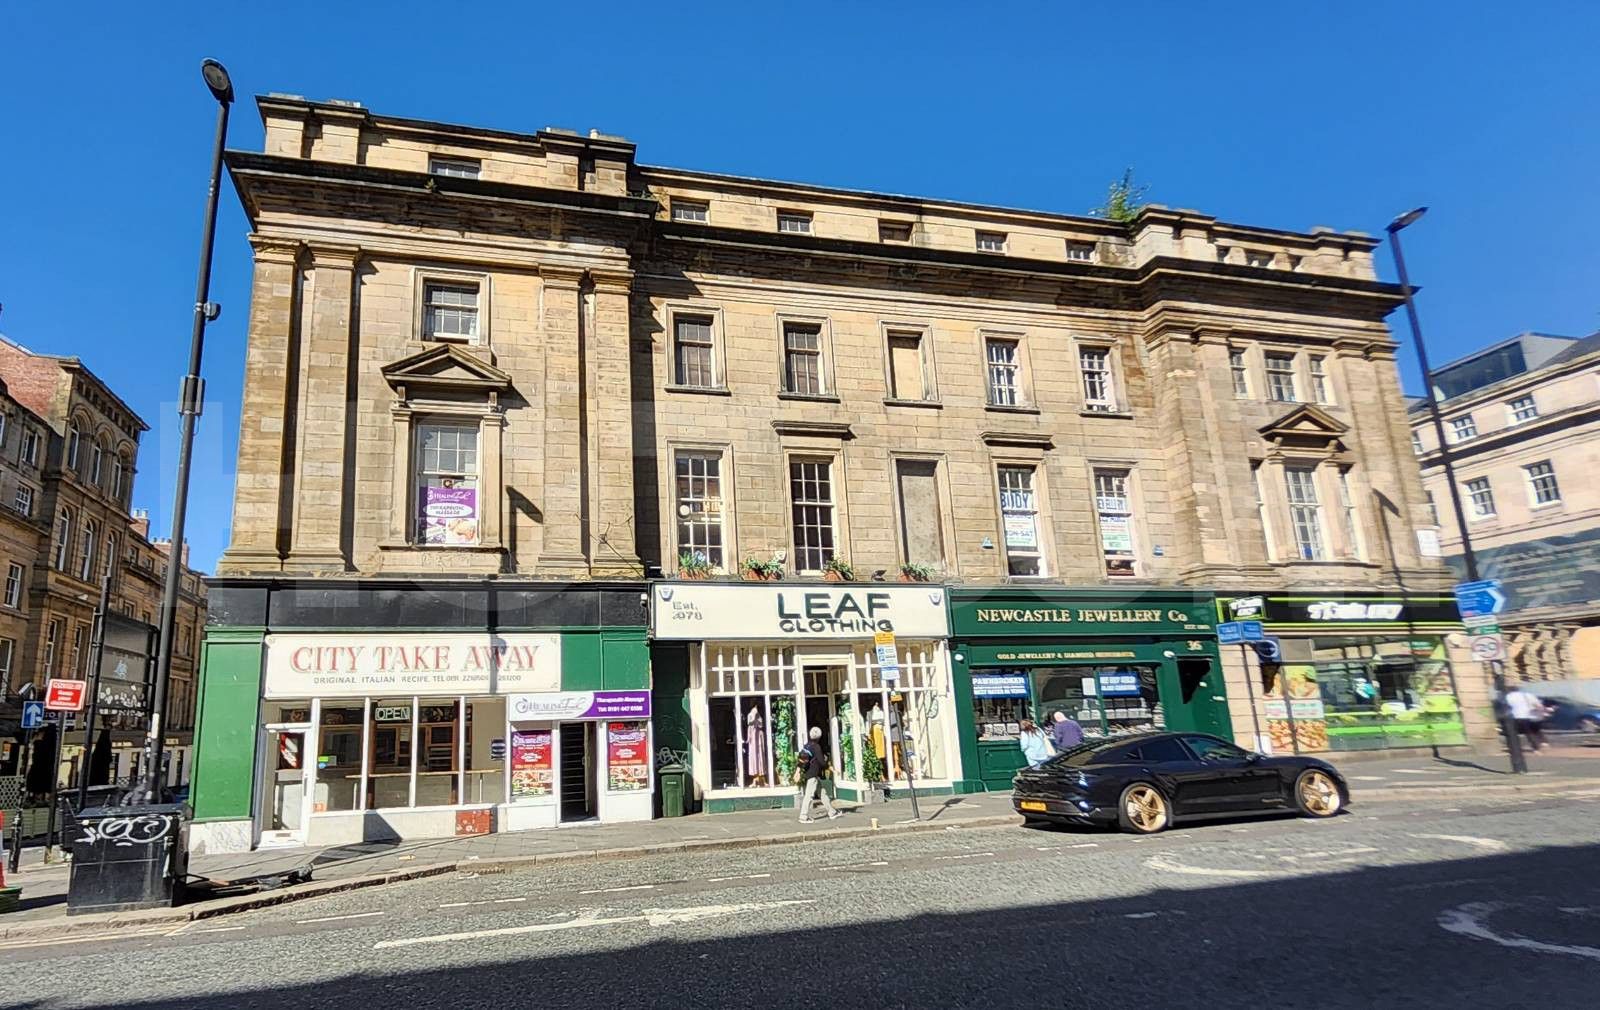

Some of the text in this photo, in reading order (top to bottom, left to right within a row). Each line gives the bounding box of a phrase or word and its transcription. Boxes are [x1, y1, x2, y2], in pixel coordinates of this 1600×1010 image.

[777, 593, 892, 619] LEAF
[977, 609, 1071, 623] NEWCASTLE
[1077, 609, 1162, 622] JEWELLERY
[779, 619, 895, 632] CLOTHING
[290, 645, 540, 674] CITY TAKE AWAY
[377, 707, 410, 720] OPEN
